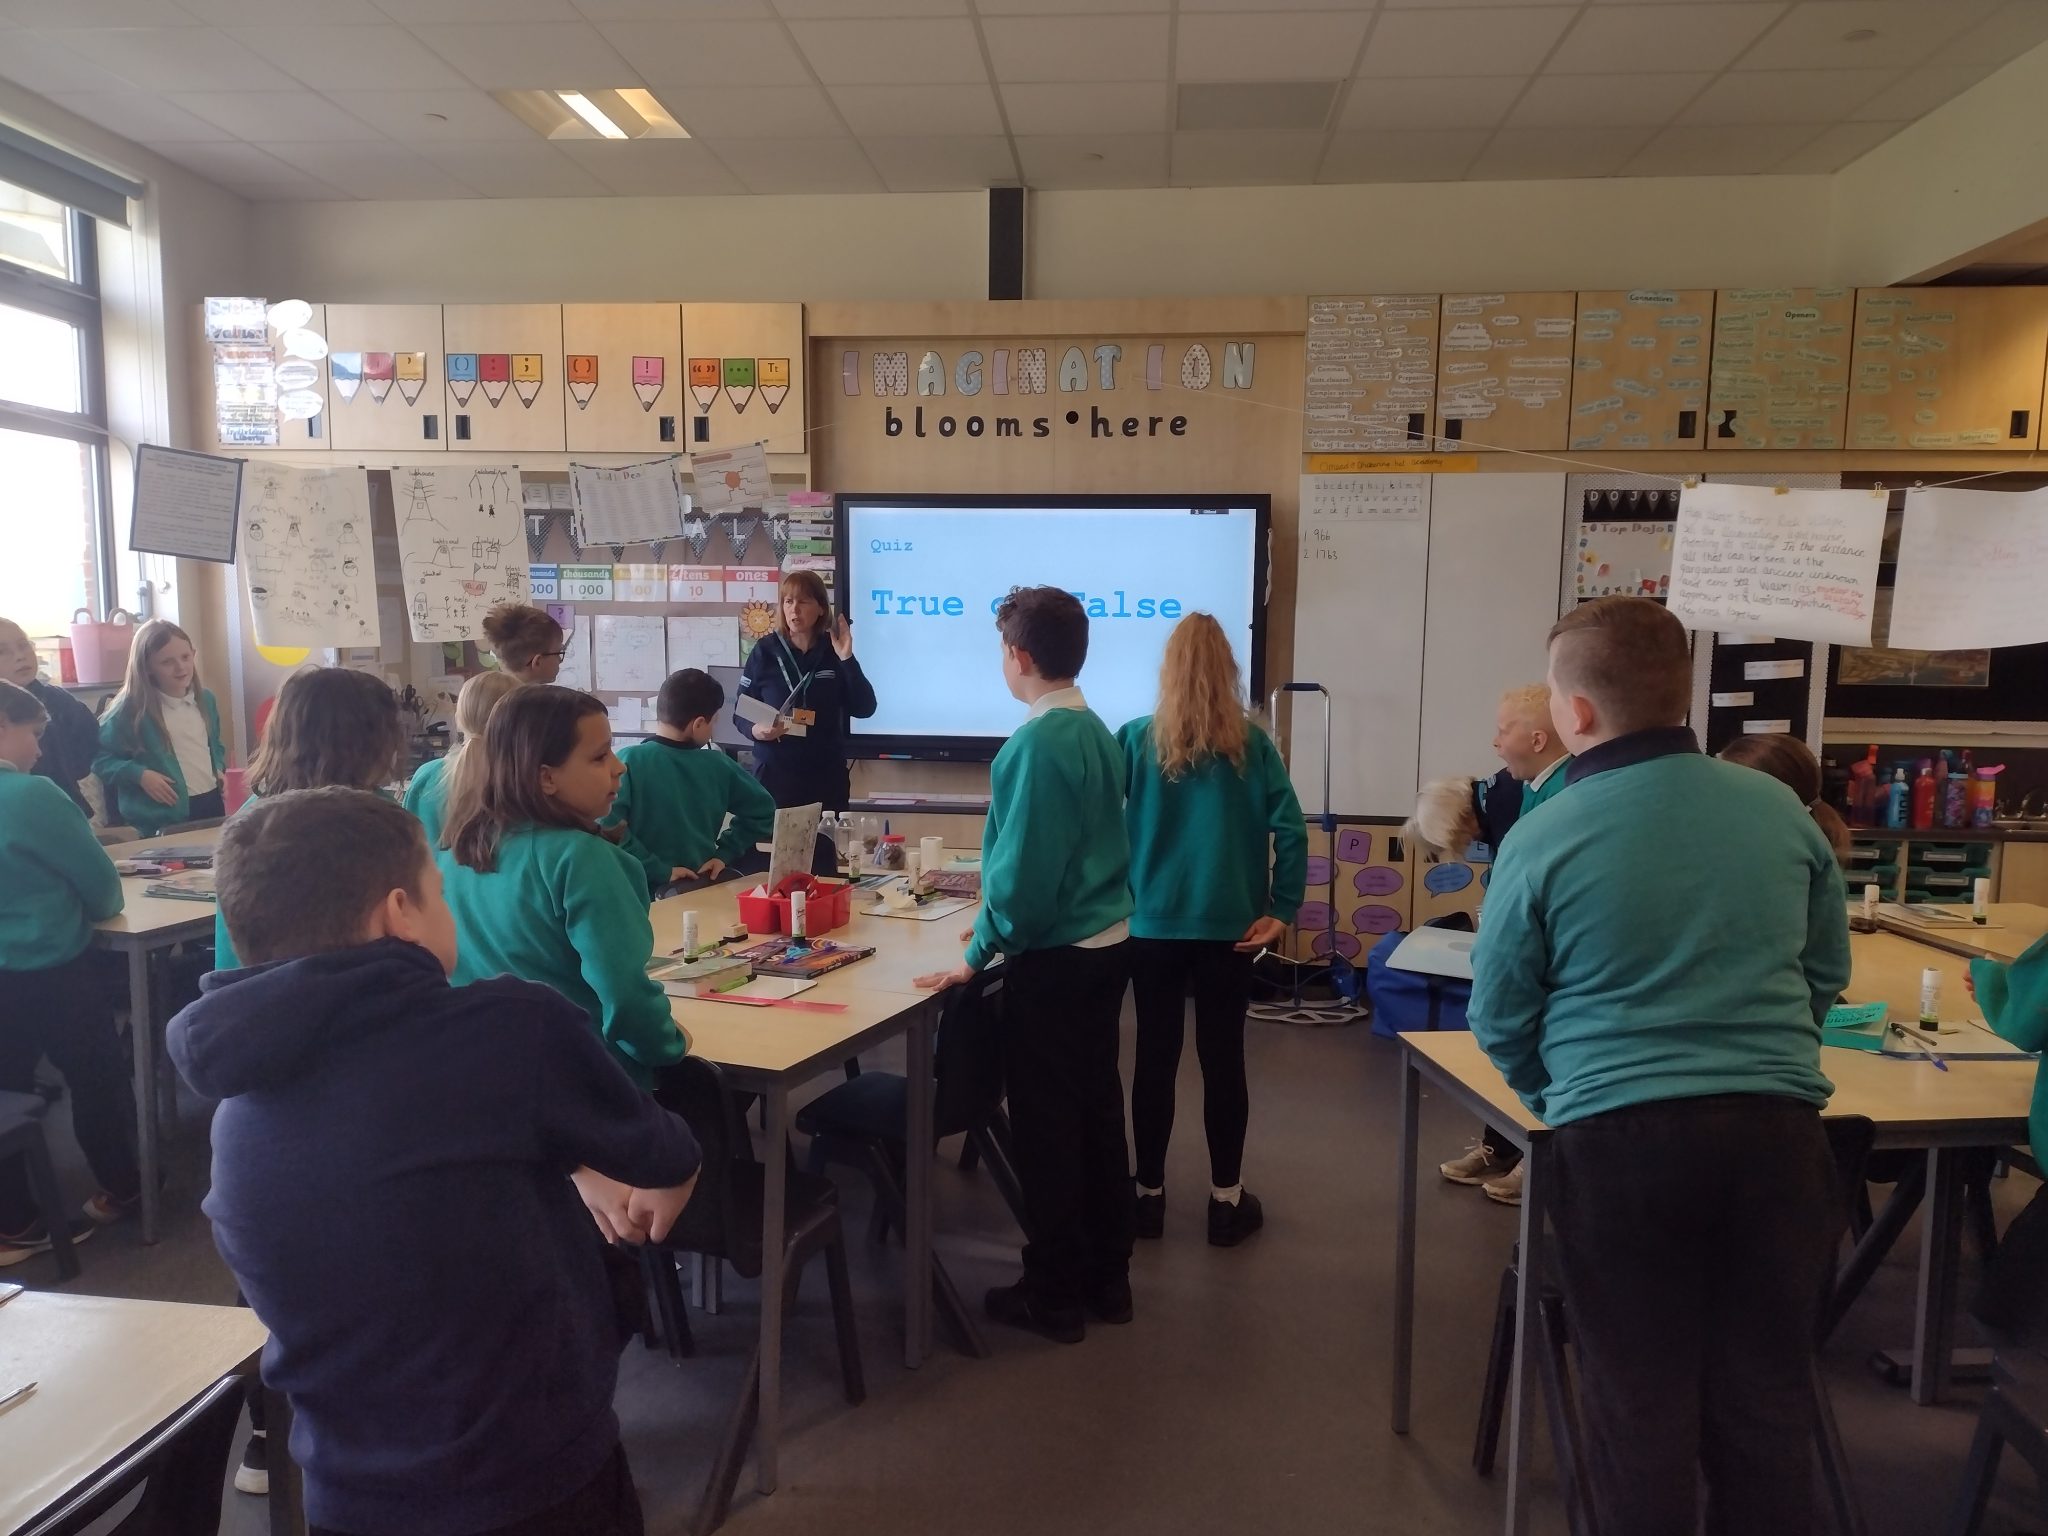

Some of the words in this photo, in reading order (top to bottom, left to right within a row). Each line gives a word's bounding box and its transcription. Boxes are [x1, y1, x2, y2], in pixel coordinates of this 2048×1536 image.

[1630, 294, 1674, 303] Connectives
[1784, 311, 1816, 320] Openers
[843, 342, 1255, 396] IMAGINATION
[886, 406, 1050, 438] blooms
[1091, 405, 1188, 438] here
[1590, 491, 1677, 501] DOJOS
[1600, 524, 1628, 534] Top
[1314, 529, 1331, 542] 966
[790, 542, 808, 550] Break
[870, 538, 914, 554] Quiz
[1800, 542, 1815, 552] the
[1316, 550, 1338, 560] 1763
[1806, 556, 1824, 568] the
[562, 570, 610, 581] thousands
[683, 571, 710, 581] tens
[735, 571, 769, 582] ones
[579, 584, 604, 596] 000
[688, 585, 704, 597] 10
[871, 589, 964, 617] True
[1350, 838, 1360, 851] P
